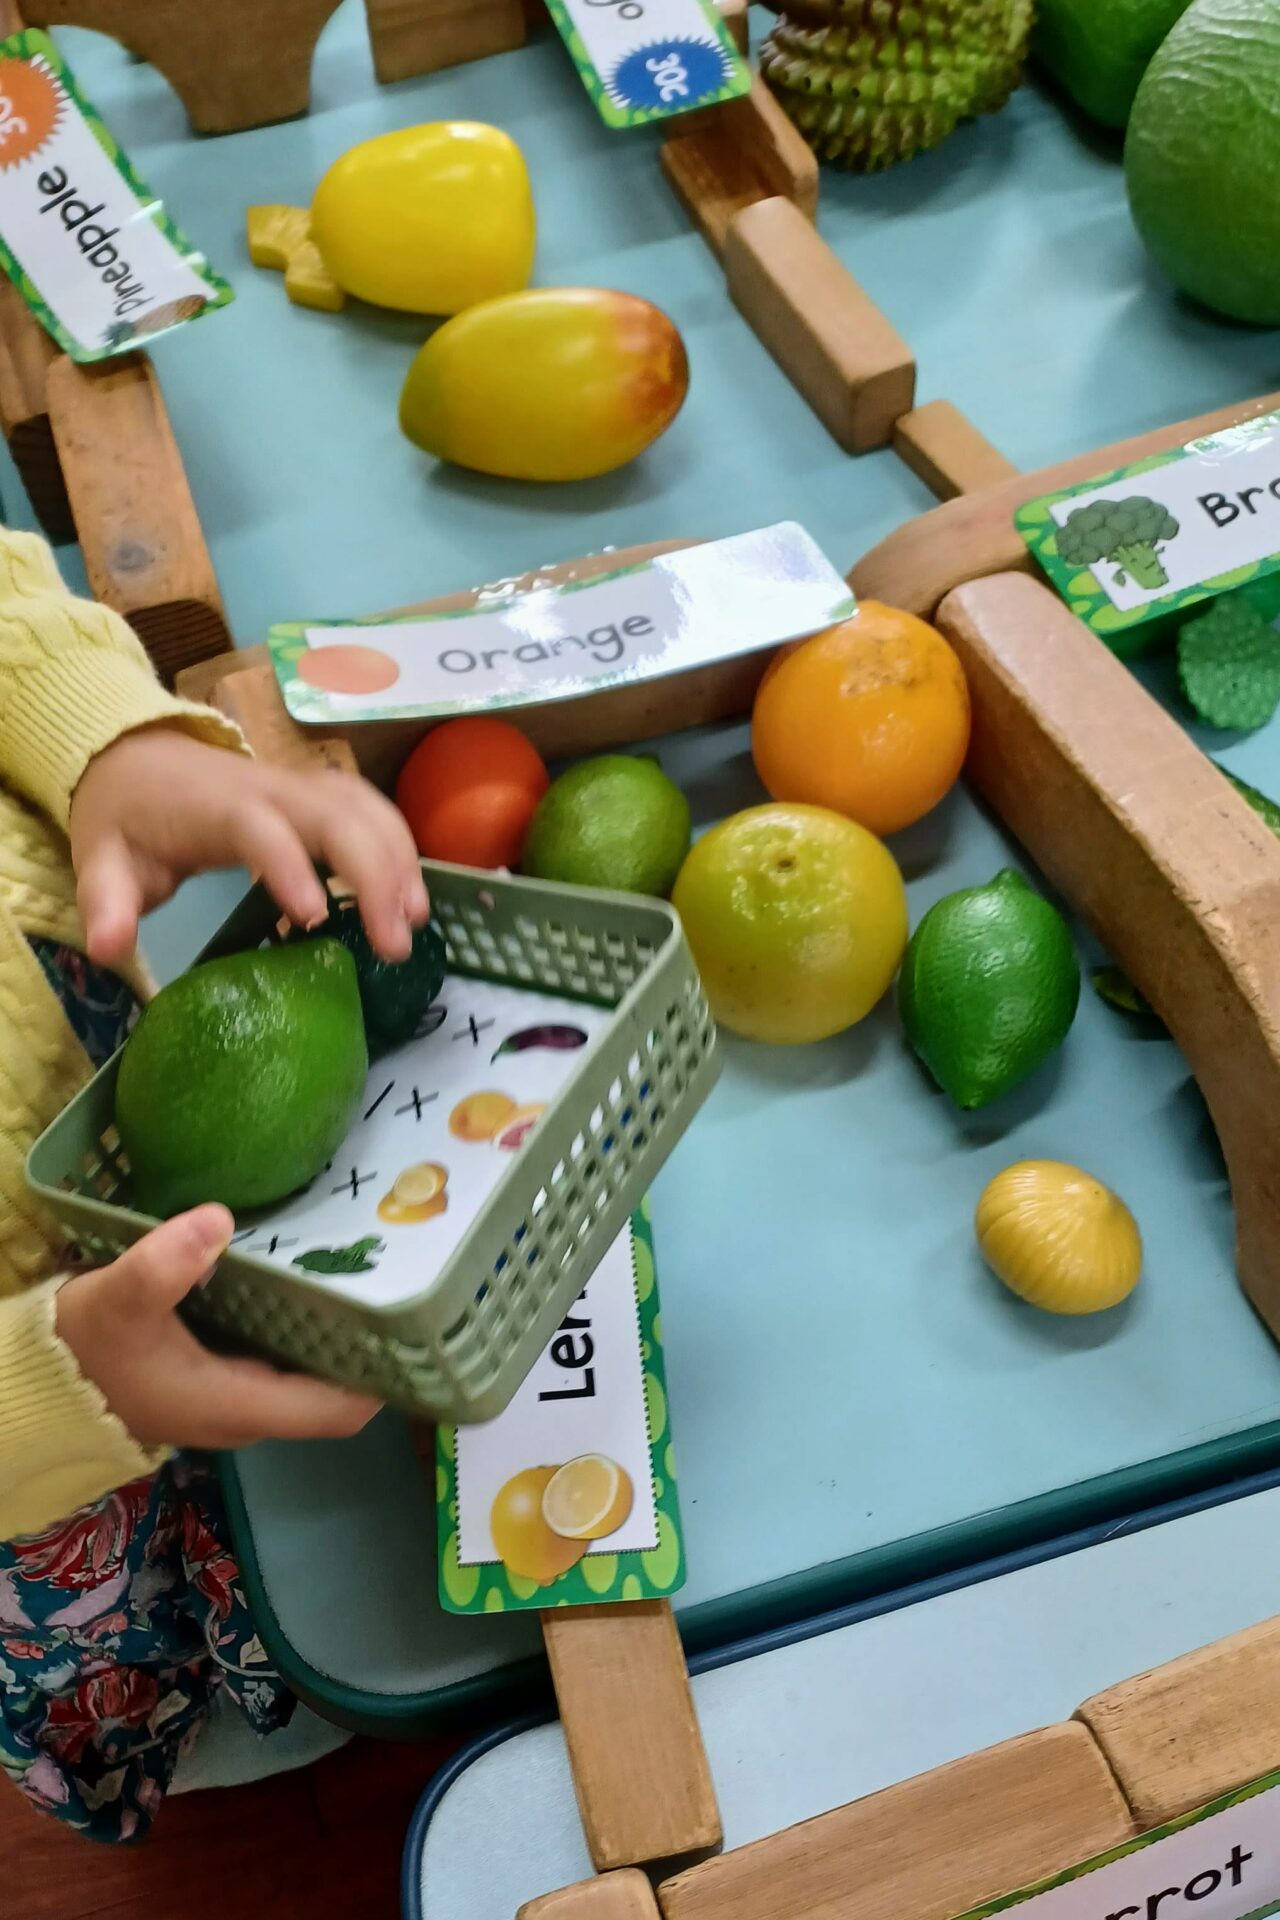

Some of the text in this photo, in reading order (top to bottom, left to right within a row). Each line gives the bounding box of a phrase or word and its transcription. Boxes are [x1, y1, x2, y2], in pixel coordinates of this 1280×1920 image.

[37, 165, 154, 316] Pineapple
[438, 615, 656, 674] Orange
[538, 1289, 596, 1402] Le
